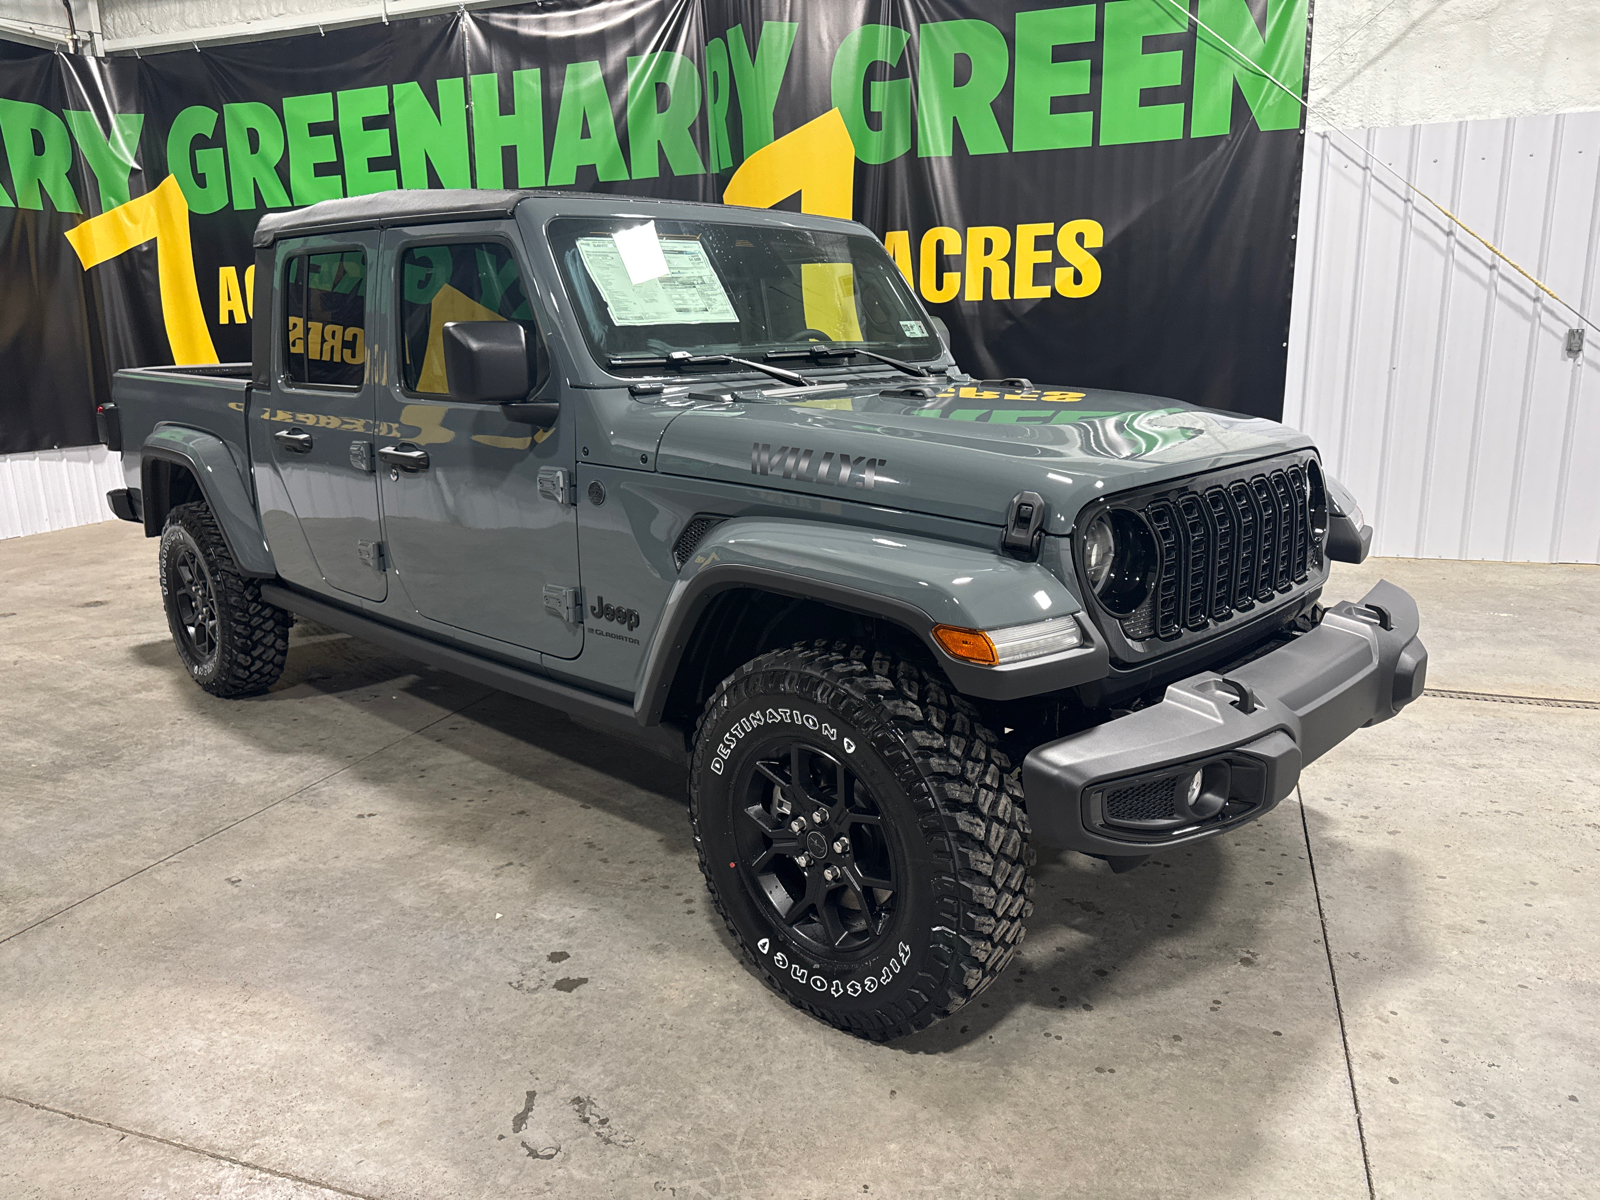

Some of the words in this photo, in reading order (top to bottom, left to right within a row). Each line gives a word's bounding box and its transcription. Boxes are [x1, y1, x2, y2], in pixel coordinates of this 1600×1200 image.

[831, 0, 1308, 164] GREEN
[0, 98, 145, 214] RY
[167, 78, 471, 214] GREEN
[64, 173, 220, 364] 7
[751, 442, 887, 490] WILLYS
[590, 595, 640, 632] Jeep
[594, 629, 641, 646] GLADIATOR
[710, 708, 837, 775] DESTINATION
[774, 941, 911, 998] Firestone
